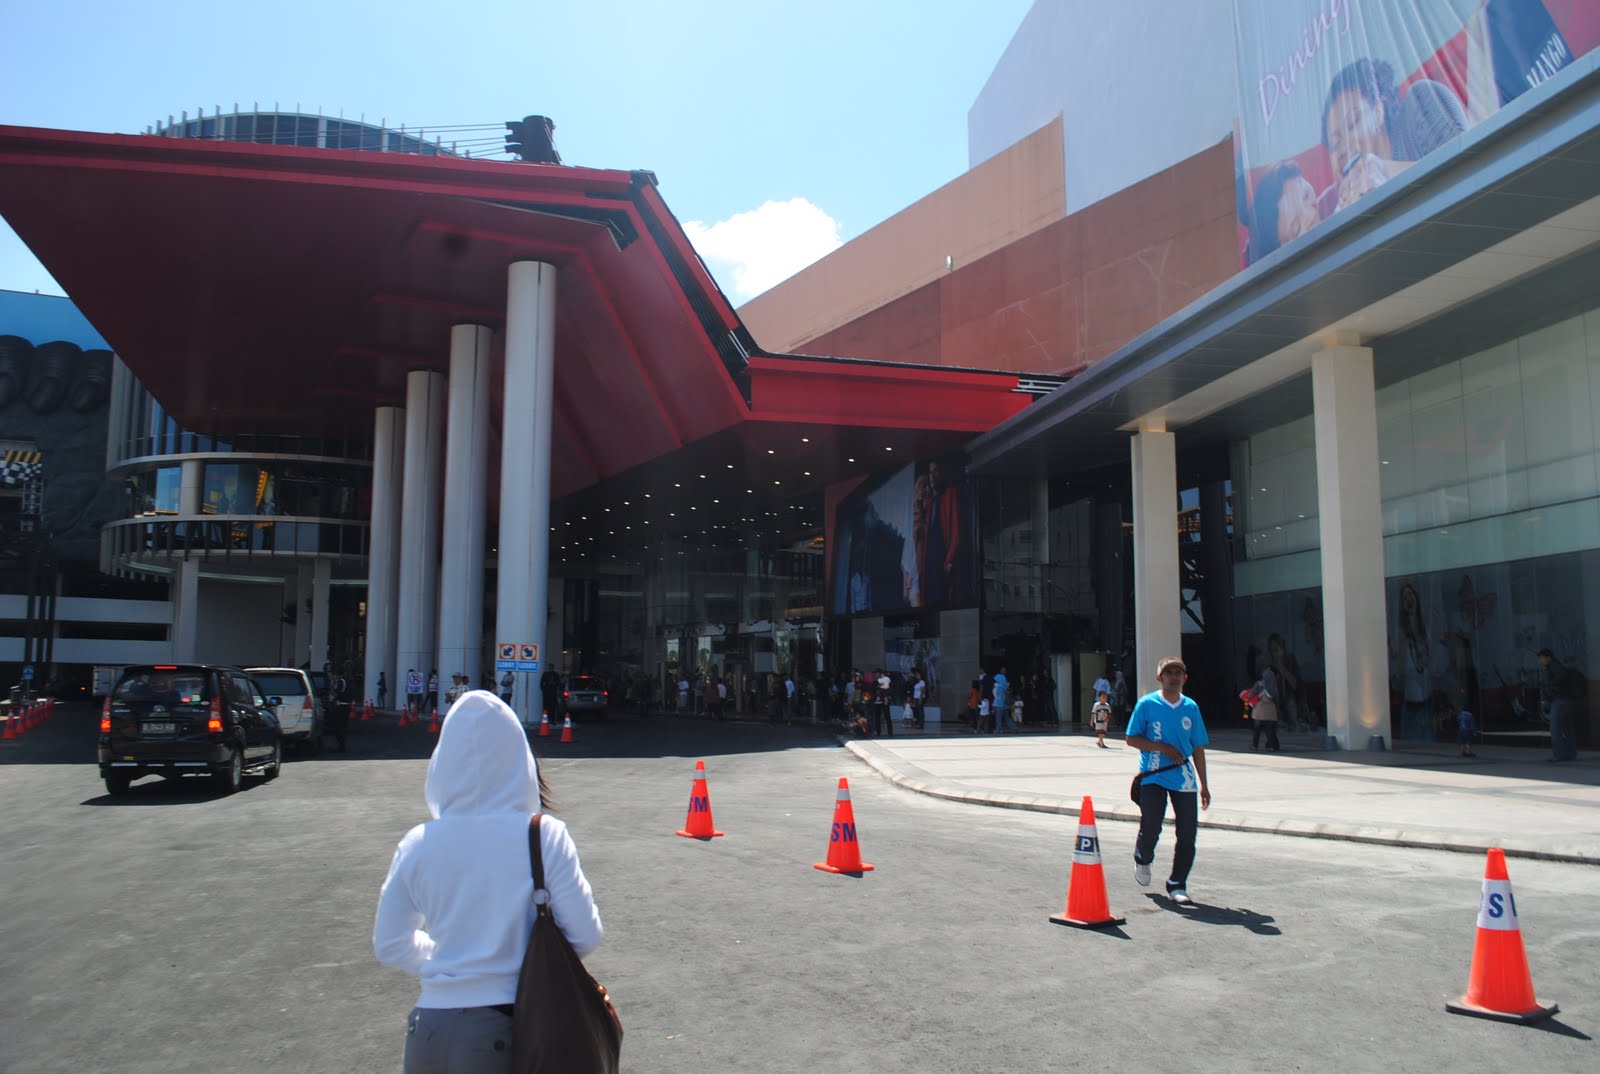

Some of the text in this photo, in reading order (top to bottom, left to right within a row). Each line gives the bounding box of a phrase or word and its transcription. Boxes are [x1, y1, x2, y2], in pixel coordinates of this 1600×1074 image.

[1526, 32, 1566, 88] MANGO
[832, 822, 857, 842] SM
[1081, 838, 1091, 850] P
[1488, 892, 1517, 919] S
